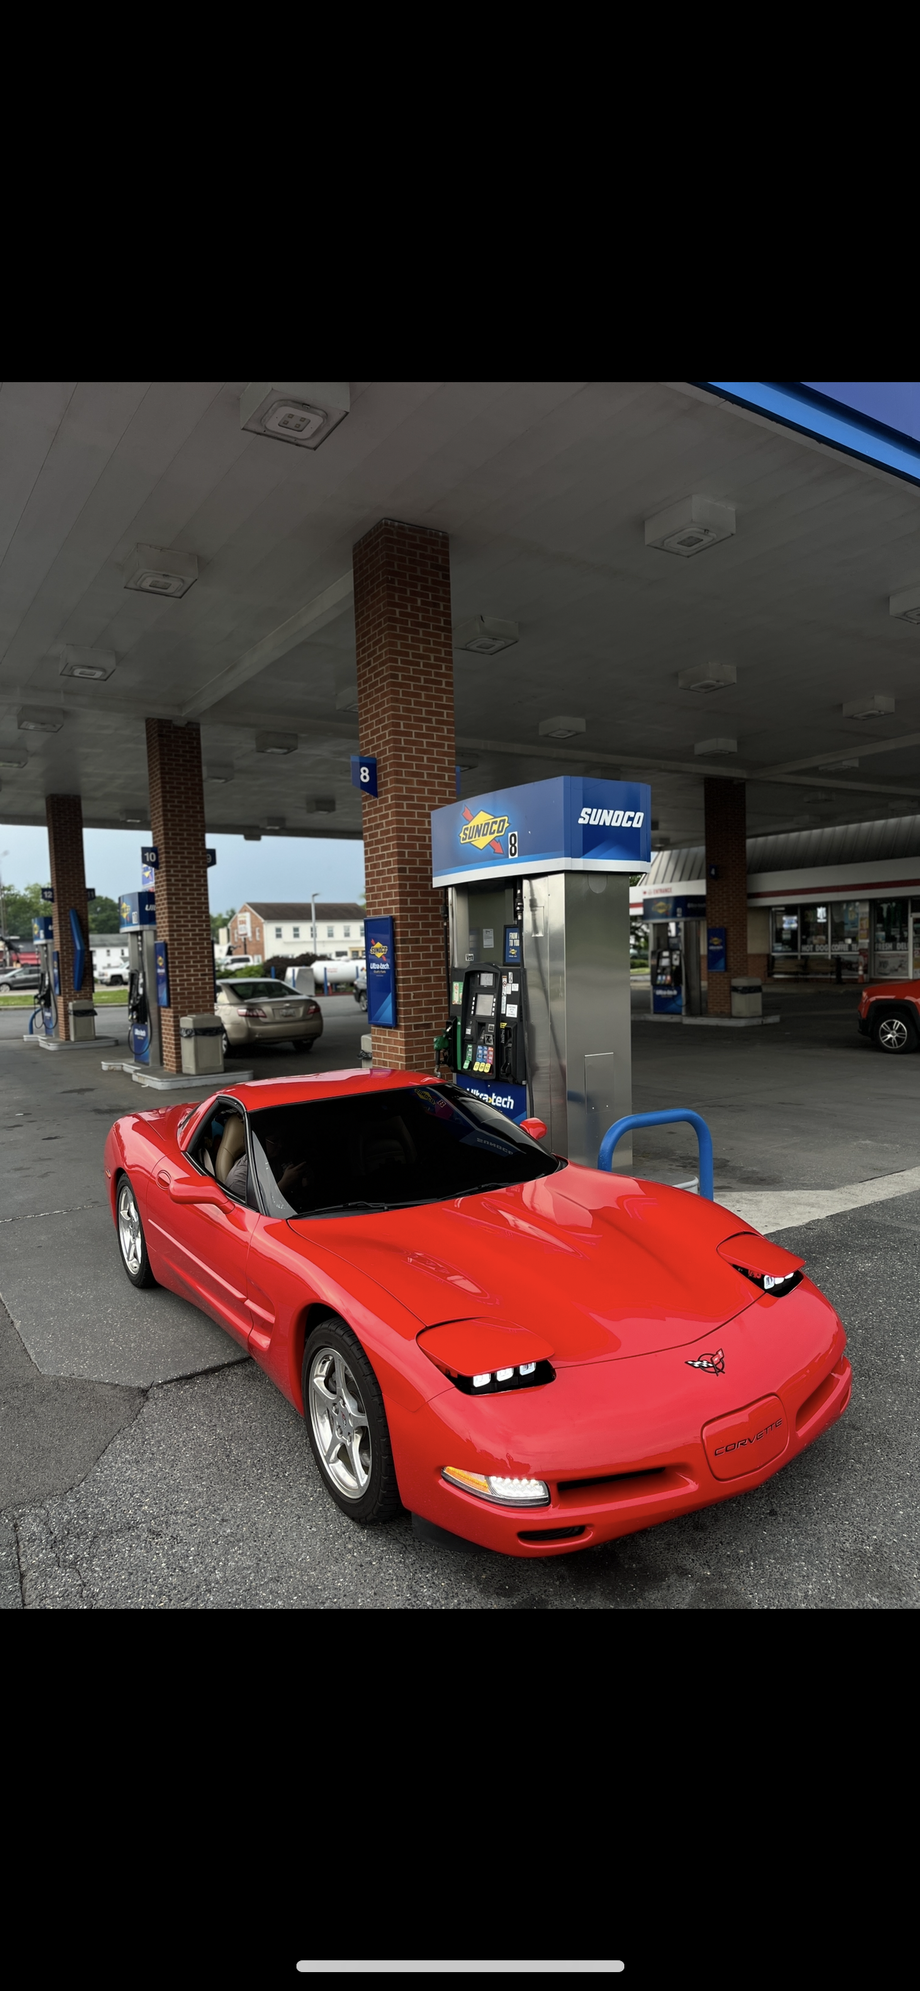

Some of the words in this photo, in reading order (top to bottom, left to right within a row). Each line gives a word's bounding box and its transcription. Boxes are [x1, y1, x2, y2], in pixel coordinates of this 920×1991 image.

[359, 766, 370, 783] 8
[578, 807, 644, 828] SUNOCO
[462, 819, 506, 841] SUNOCO
[509, 833, 517, 857] 8
[144, 852, 156, 862] 10
[801, 944, 814, 952] HOT
[832, 944, 849, 952] COFFEE
[714, 1417, 783, 1456] CORVETTE
